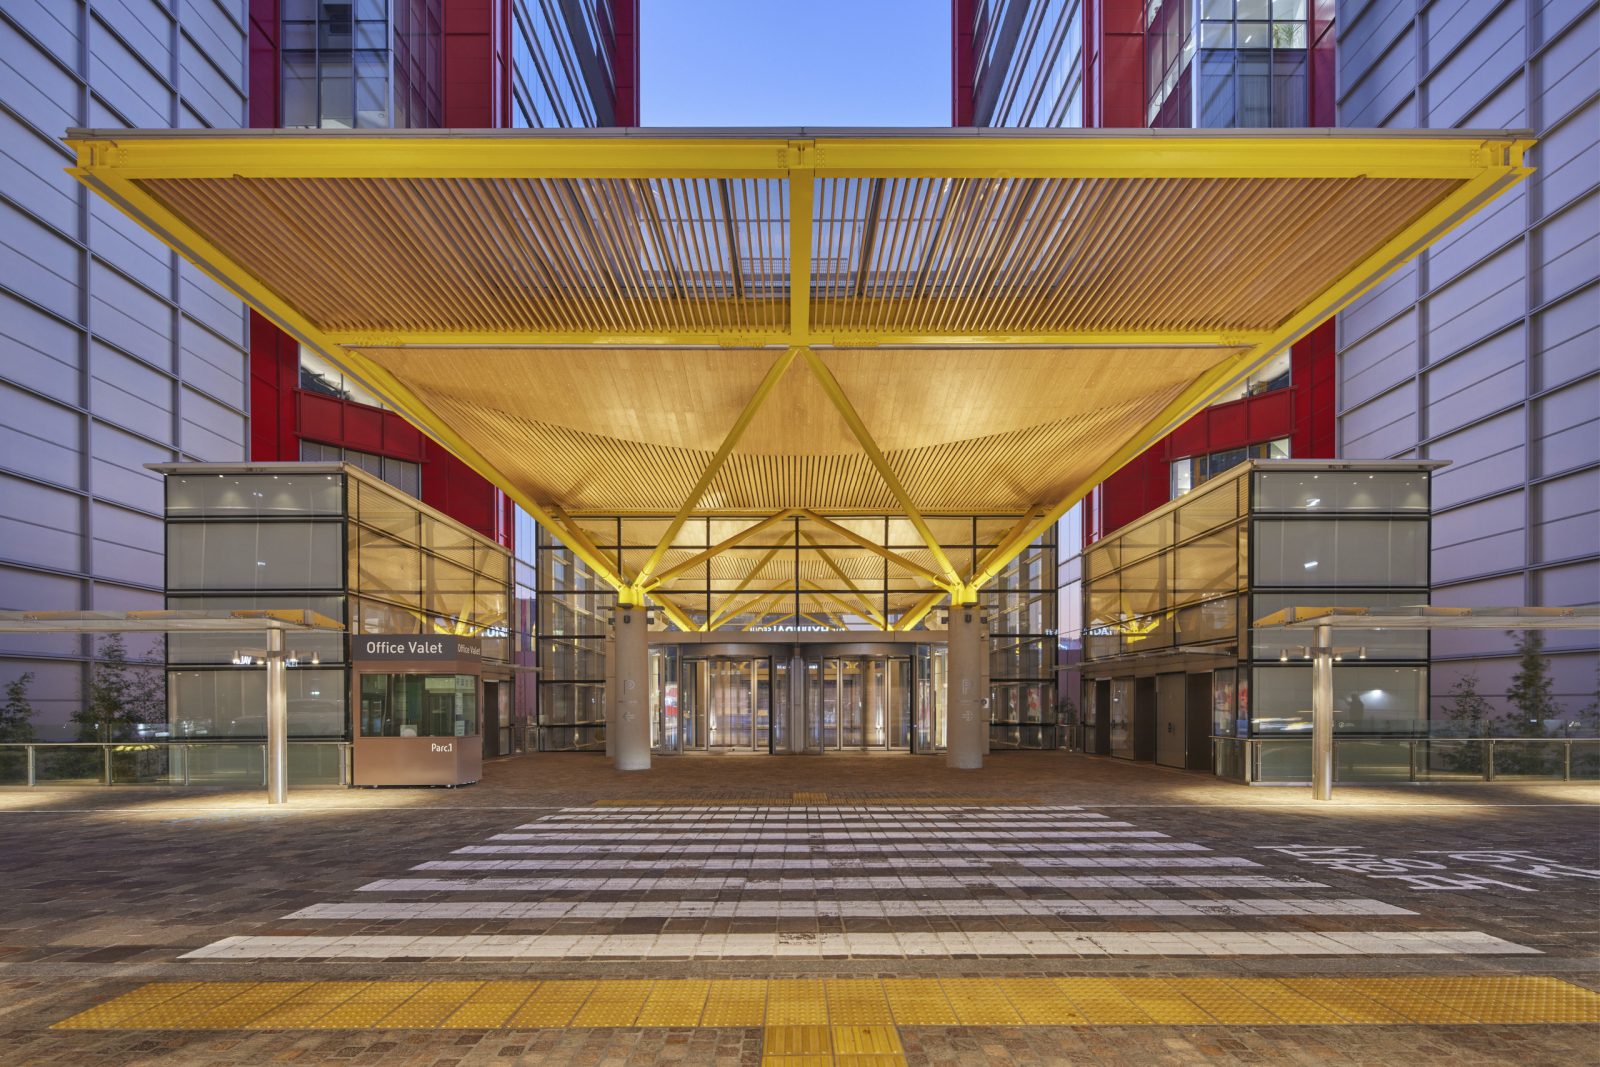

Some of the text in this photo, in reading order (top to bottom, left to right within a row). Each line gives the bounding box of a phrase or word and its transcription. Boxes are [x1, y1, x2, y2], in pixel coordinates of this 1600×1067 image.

[366, 641, 443, 654] Office Valet
[457, 643, 481, 656] Office Valet
[431, 743, 453, 752] Parc.1
[1253, 843, 1540, 892] 보행자
